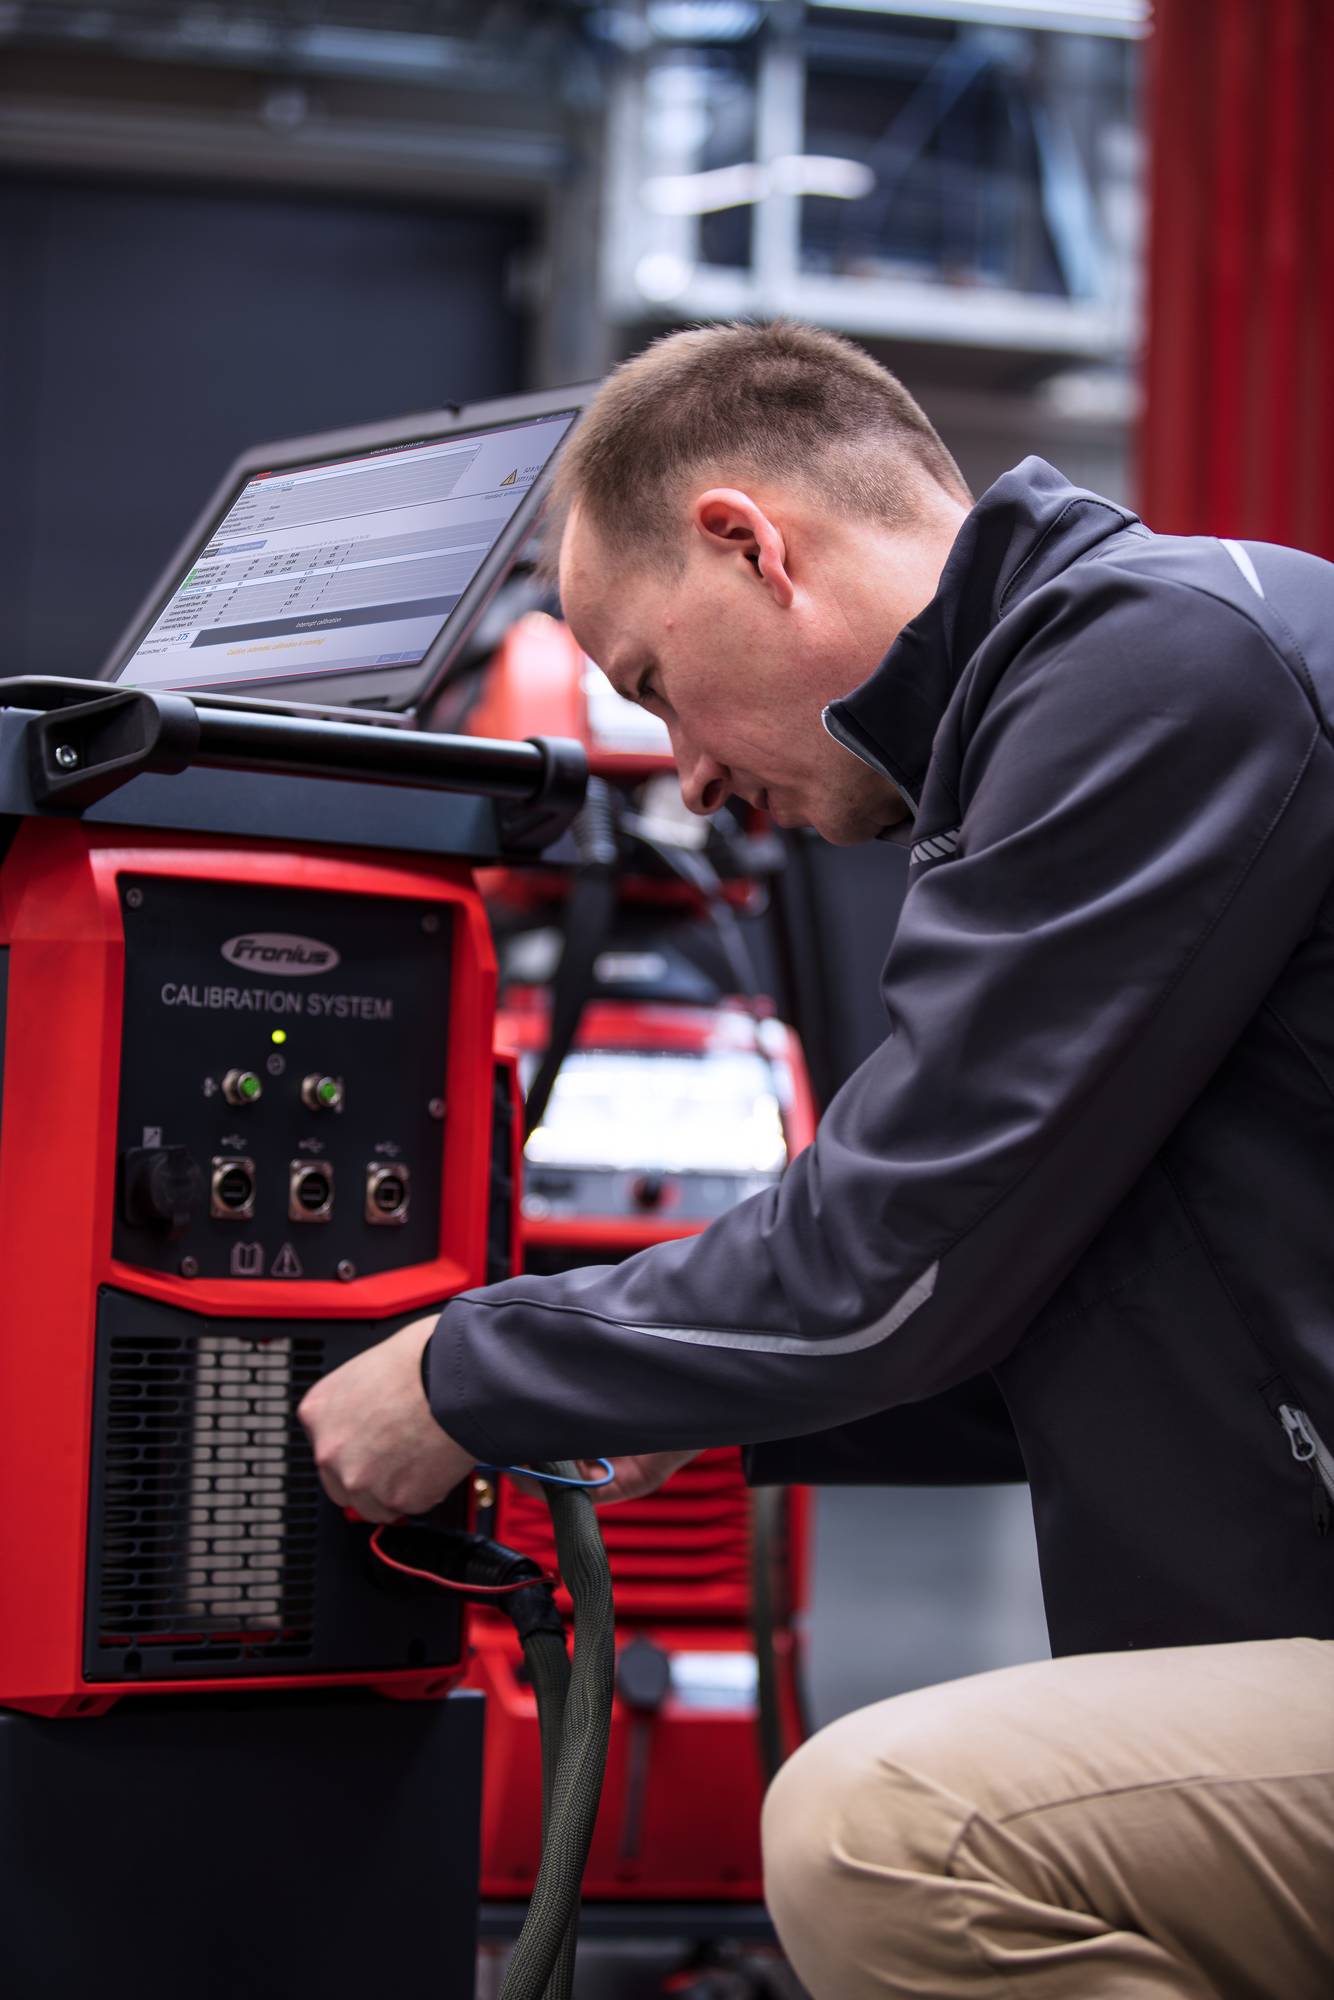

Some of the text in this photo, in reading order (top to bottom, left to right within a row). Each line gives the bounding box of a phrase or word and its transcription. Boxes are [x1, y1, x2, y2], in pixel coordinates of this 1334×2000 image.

[231, 938, 330, 967] Fronius
[161, 983, 394, 1021] CALIBRATION SYSTEM
